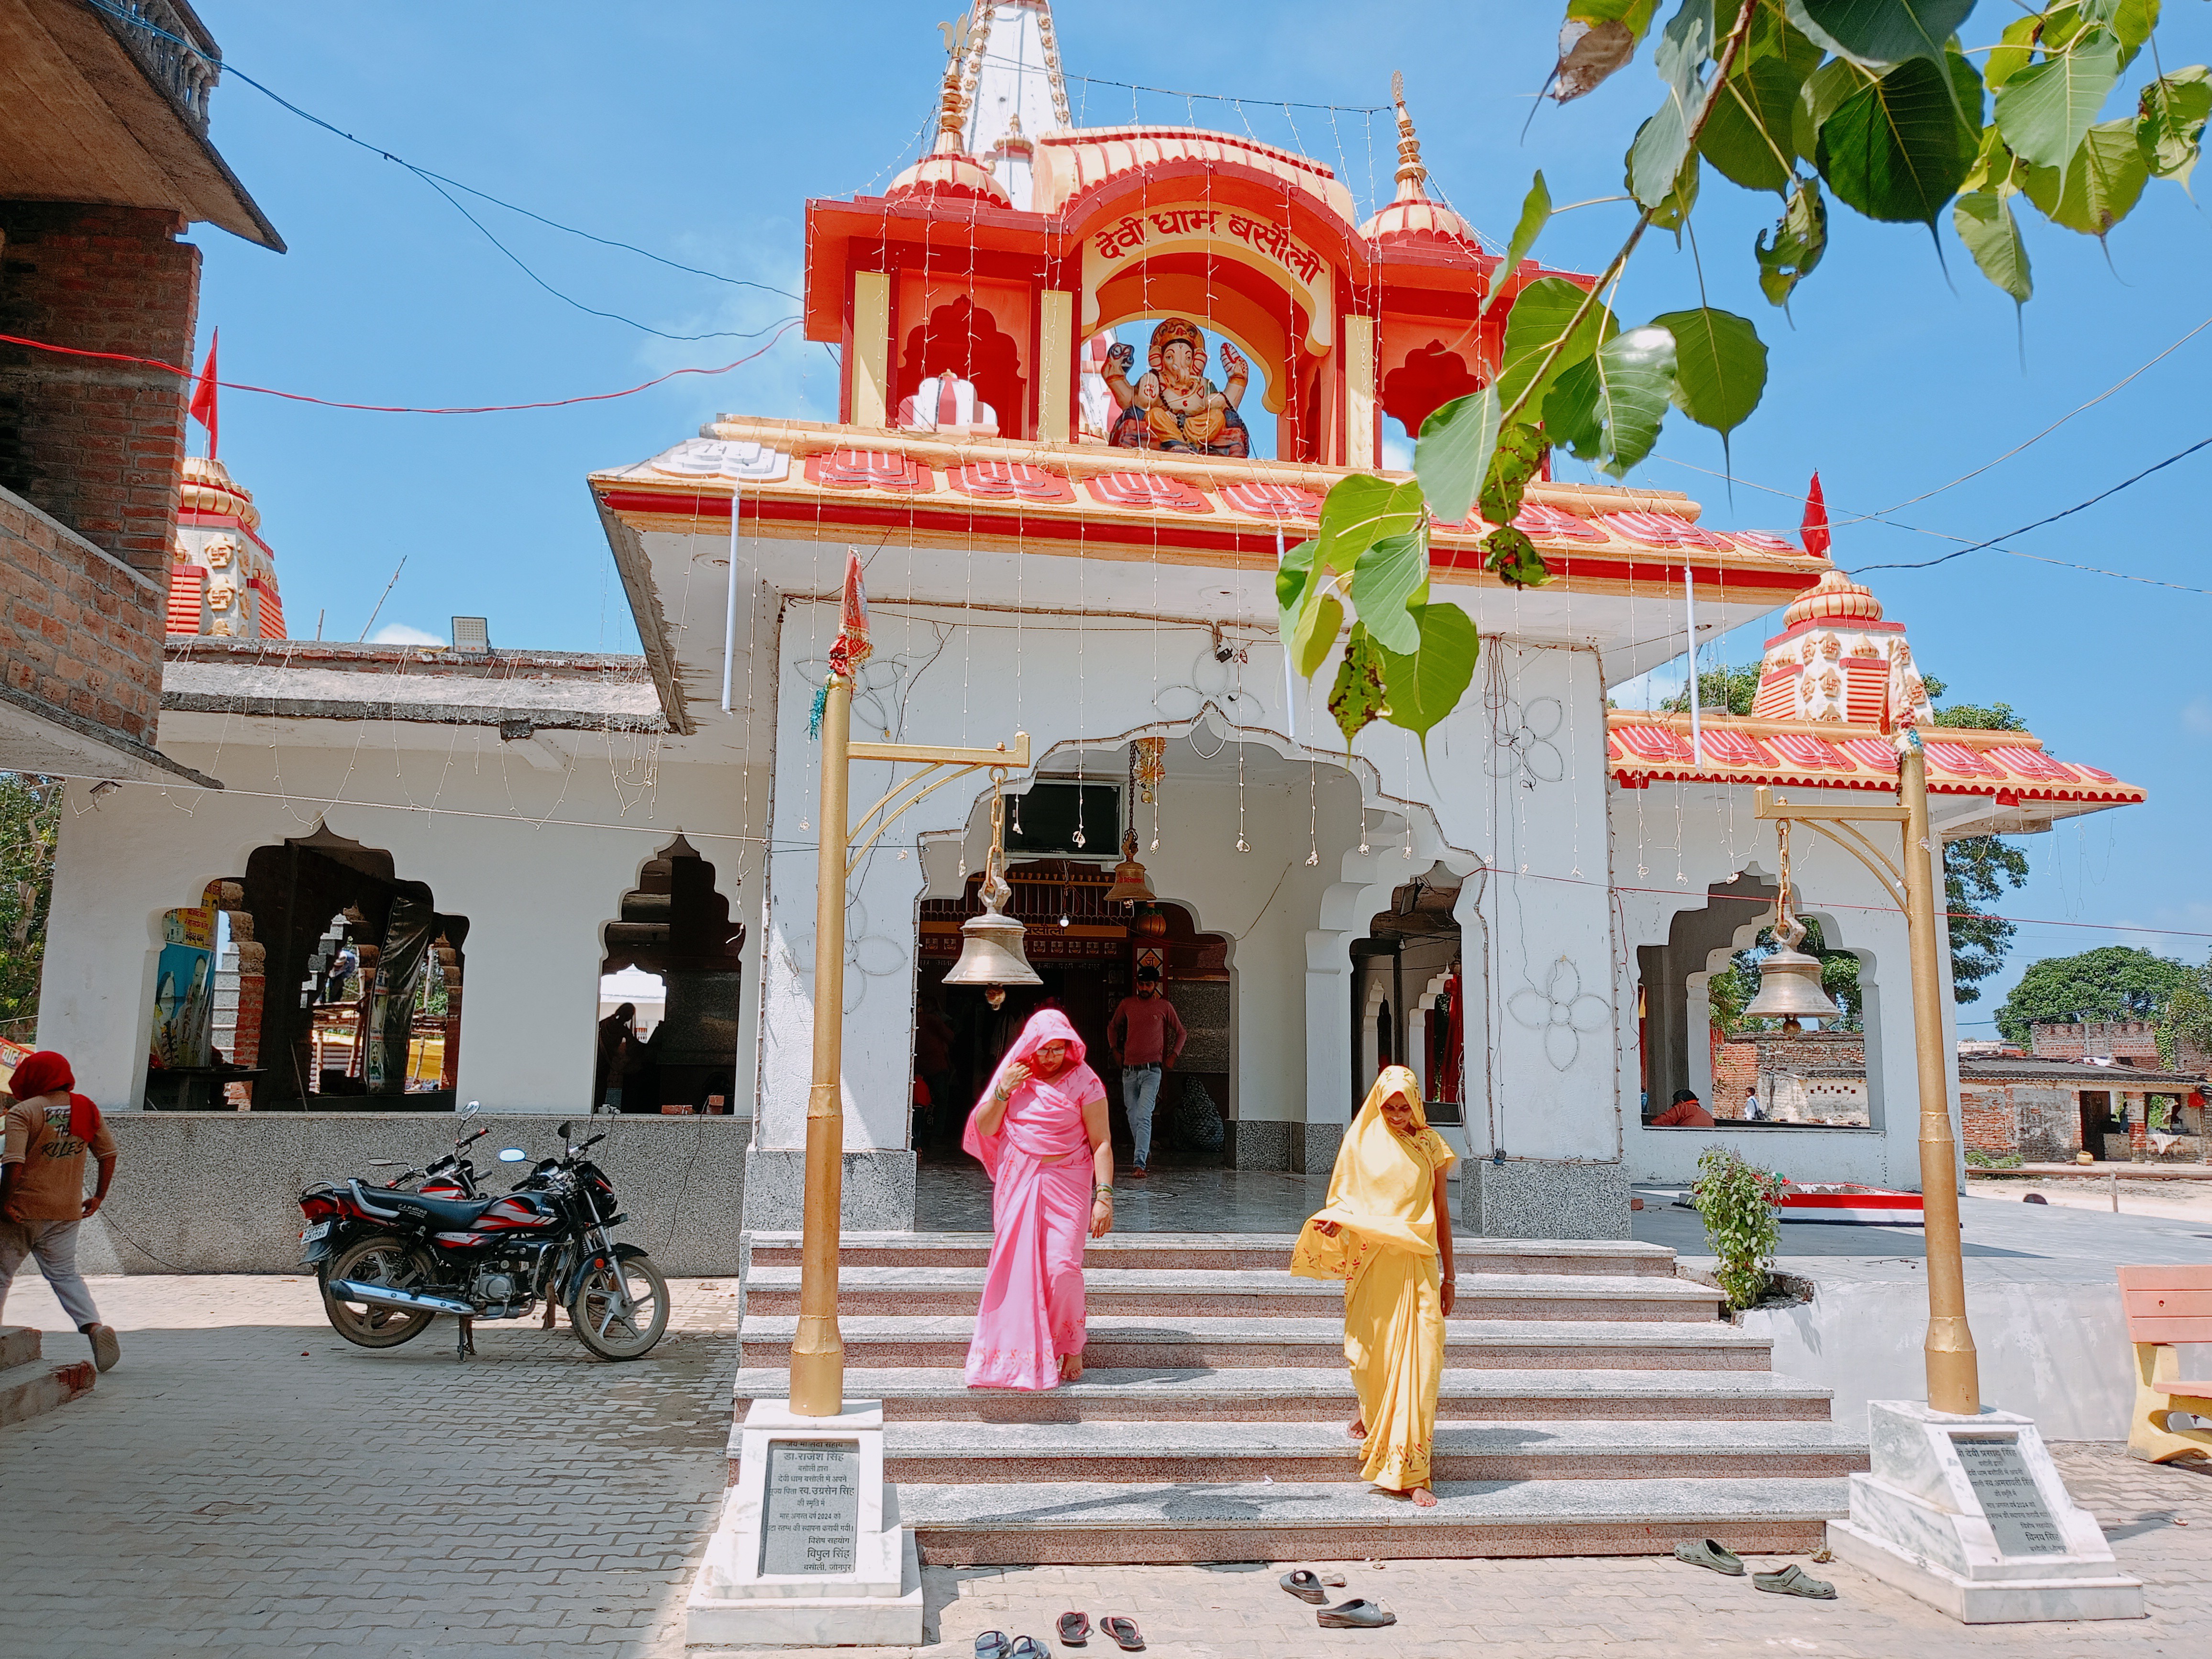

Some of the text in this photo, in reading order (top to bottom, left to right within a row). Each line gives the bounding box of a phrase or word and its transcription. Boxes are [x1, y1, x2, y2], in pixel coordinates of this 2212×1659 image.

[1095, 217, 1144, 259] देवी
[1149, 210, 1223, 234] धाम
[55, 1122, 70, 1137] TH
[41, 1141, 85, 1158] RULES
[1965, 1448, 1980, 1457] देवी
[2001, 1447, 2017, 1457] सिंह
[778, 1474, 789, 1482] देवी
[832, 1474, 847, 1482] अपने
[784, 1486, 797, 1495] पिता
[828, 1536, 850, 1544] सहयोग
[2025, 1531, 2060, 1541] विनय सिंह
[807, 1547, 850, 1561] विपुल सिंह
